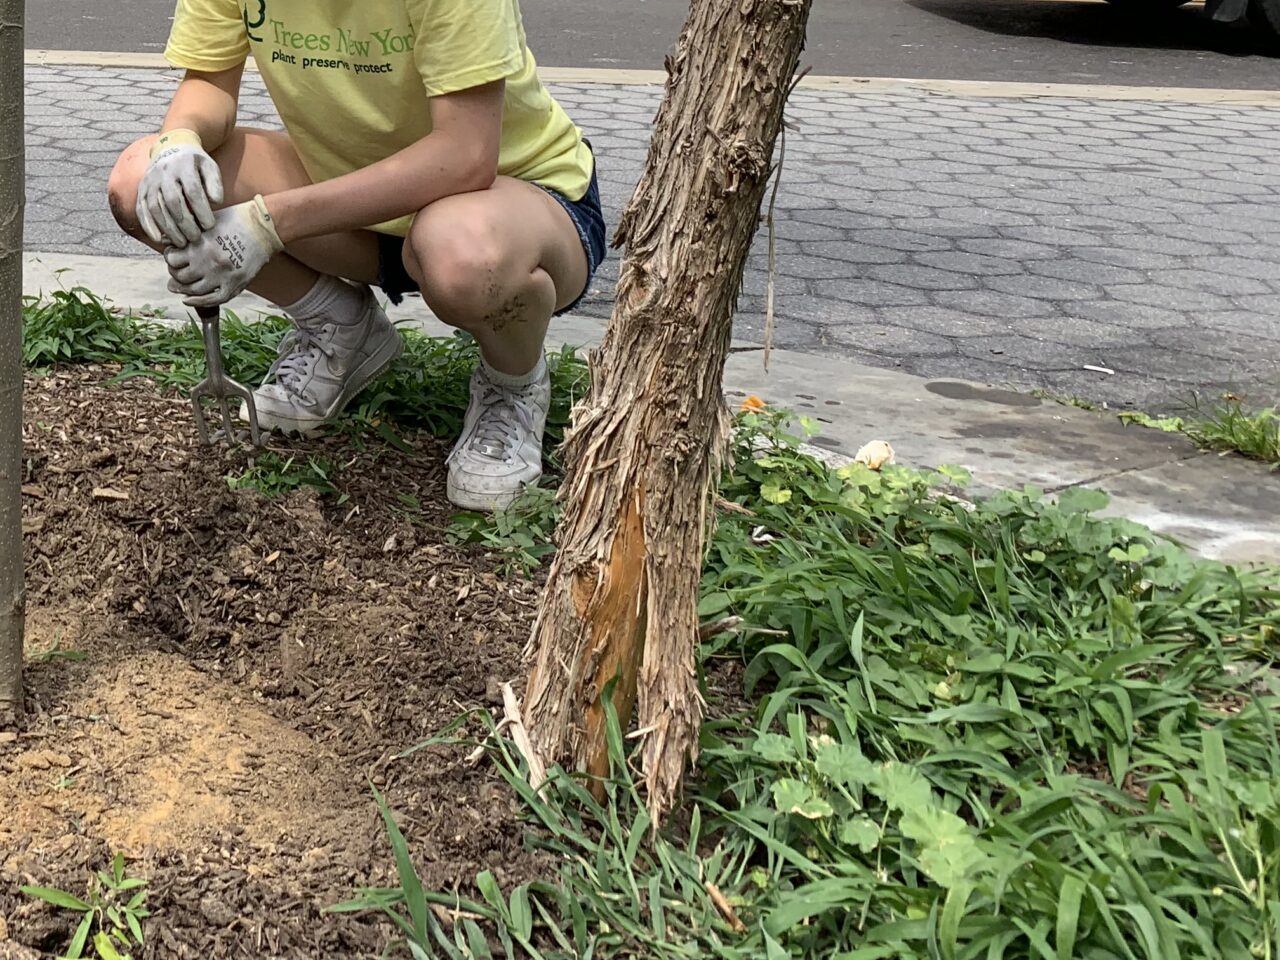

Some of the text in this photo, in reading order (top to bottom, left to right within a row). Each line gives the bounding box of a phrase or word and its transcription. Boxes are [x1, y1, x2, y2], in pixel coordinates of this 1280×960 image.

[269, 19, 415, 57] Trees New Yor
[272, 49, 297, 64] plant
[353, 62, 393, 74] protect
[215, 235, 242, 269] ATLAS
